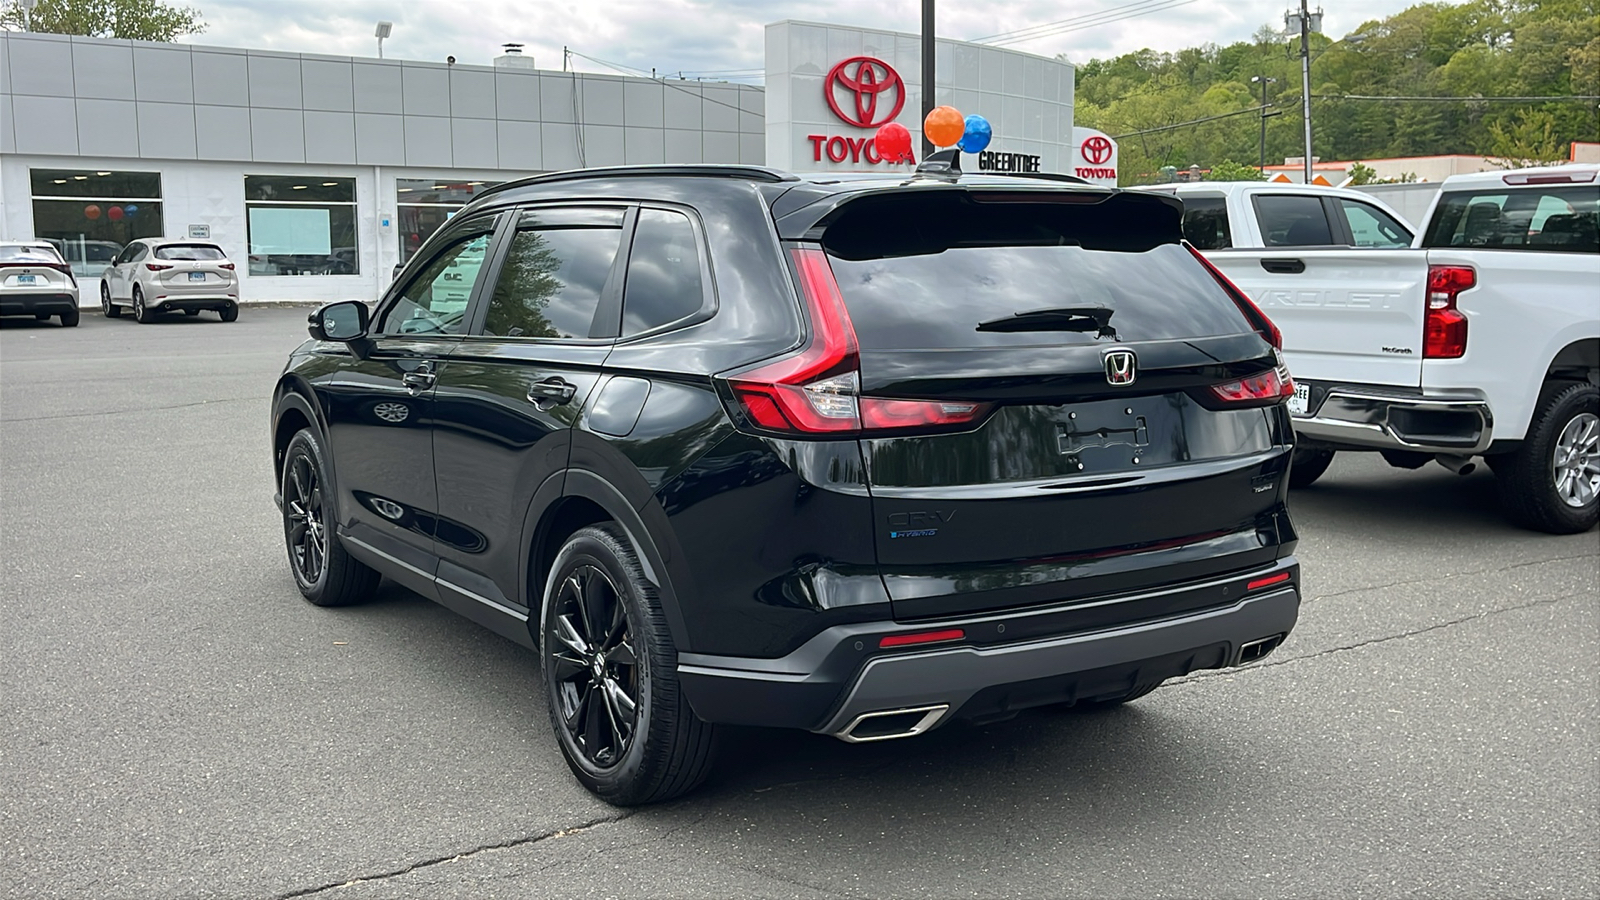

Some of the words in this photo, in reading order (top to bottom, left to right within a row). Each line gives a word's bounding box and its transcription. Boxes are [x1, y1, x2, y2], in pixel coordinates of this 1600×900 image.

[808, 135, 916, 165] TOYOA
[978, 151, 1041, 173] GREENTREE
[1075, 167, 1117, 179] TOYOTA
[1243, 288, 1401, 309] VROLET
[1381, 346, 1413, 355] McGrath
[886, 509, 957, 526] CR-V
[897, 530, 936, 538] HYBRID
